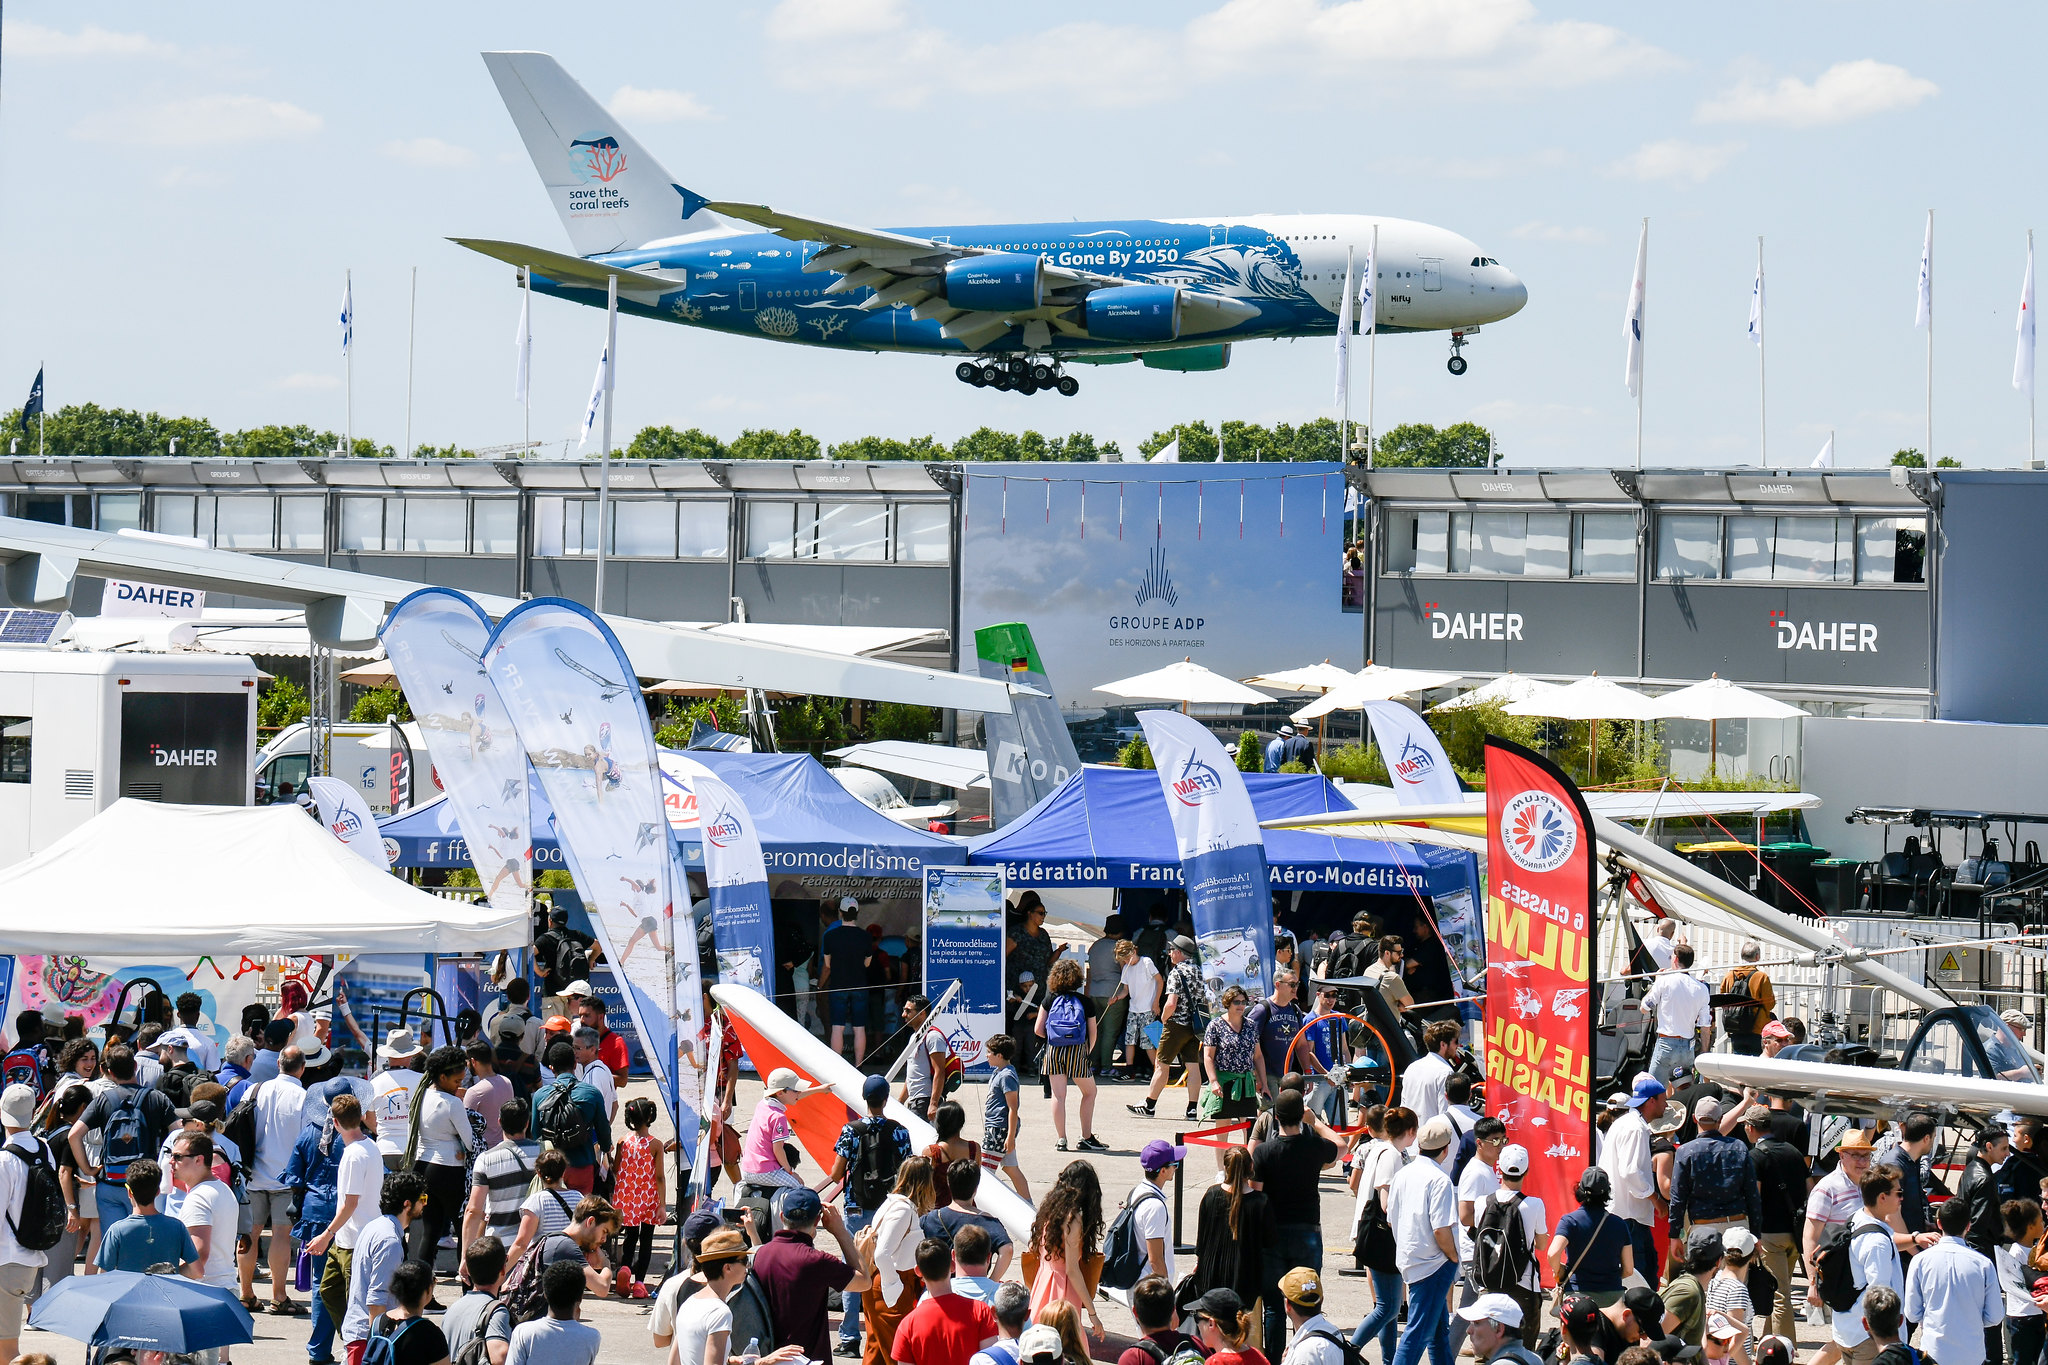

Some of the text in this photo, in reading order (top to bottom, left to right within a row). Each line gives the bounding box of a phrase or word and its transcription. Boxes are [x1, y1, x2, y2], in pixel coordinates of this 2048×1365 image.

[569, 187, 619, 199] save the
[569, 197, 629, 210] coral reefs
[1058, 251, 1105, 266] Gone
[1109, 250, 1132, 268] By
[1135, 248, 1179, 264] 2050
[1391, 295, 1412, 305] Hifly
[1481, 482, 1514, 492] DAHER
[1759, 484, 1794, 494] DAHER
[117, 582, 195, 609] DAHER
[1109, 616, 1205, 630] GROUPE ADP
[1431, 609, 1523, 641] DAHER
[1777, 618, 1878, 653] DAHER
[1109, 638, 1205, 648] DES HORIZONS À PARTAGER
[154, 747, 218, 767] DAHER
[1006, 752, 1070, 786] KOD
[362, 780, 374, 788] 15
[664, 793, 698, 810] AM
[763, 847, 921, 871] eromodelisme
[800, 875, 866, 887] Fédération
[870, 876, 922, 888] Français
[1130, 863, 1186, 886] Franç
[1266, 863, 1430, 889] 'Aéro-Modélism
[931, 938, 998, 948] l'Aéromodélisme
[940, 949, 958, 957] pieds
[950, 1040, 981, 1052] FFAM
